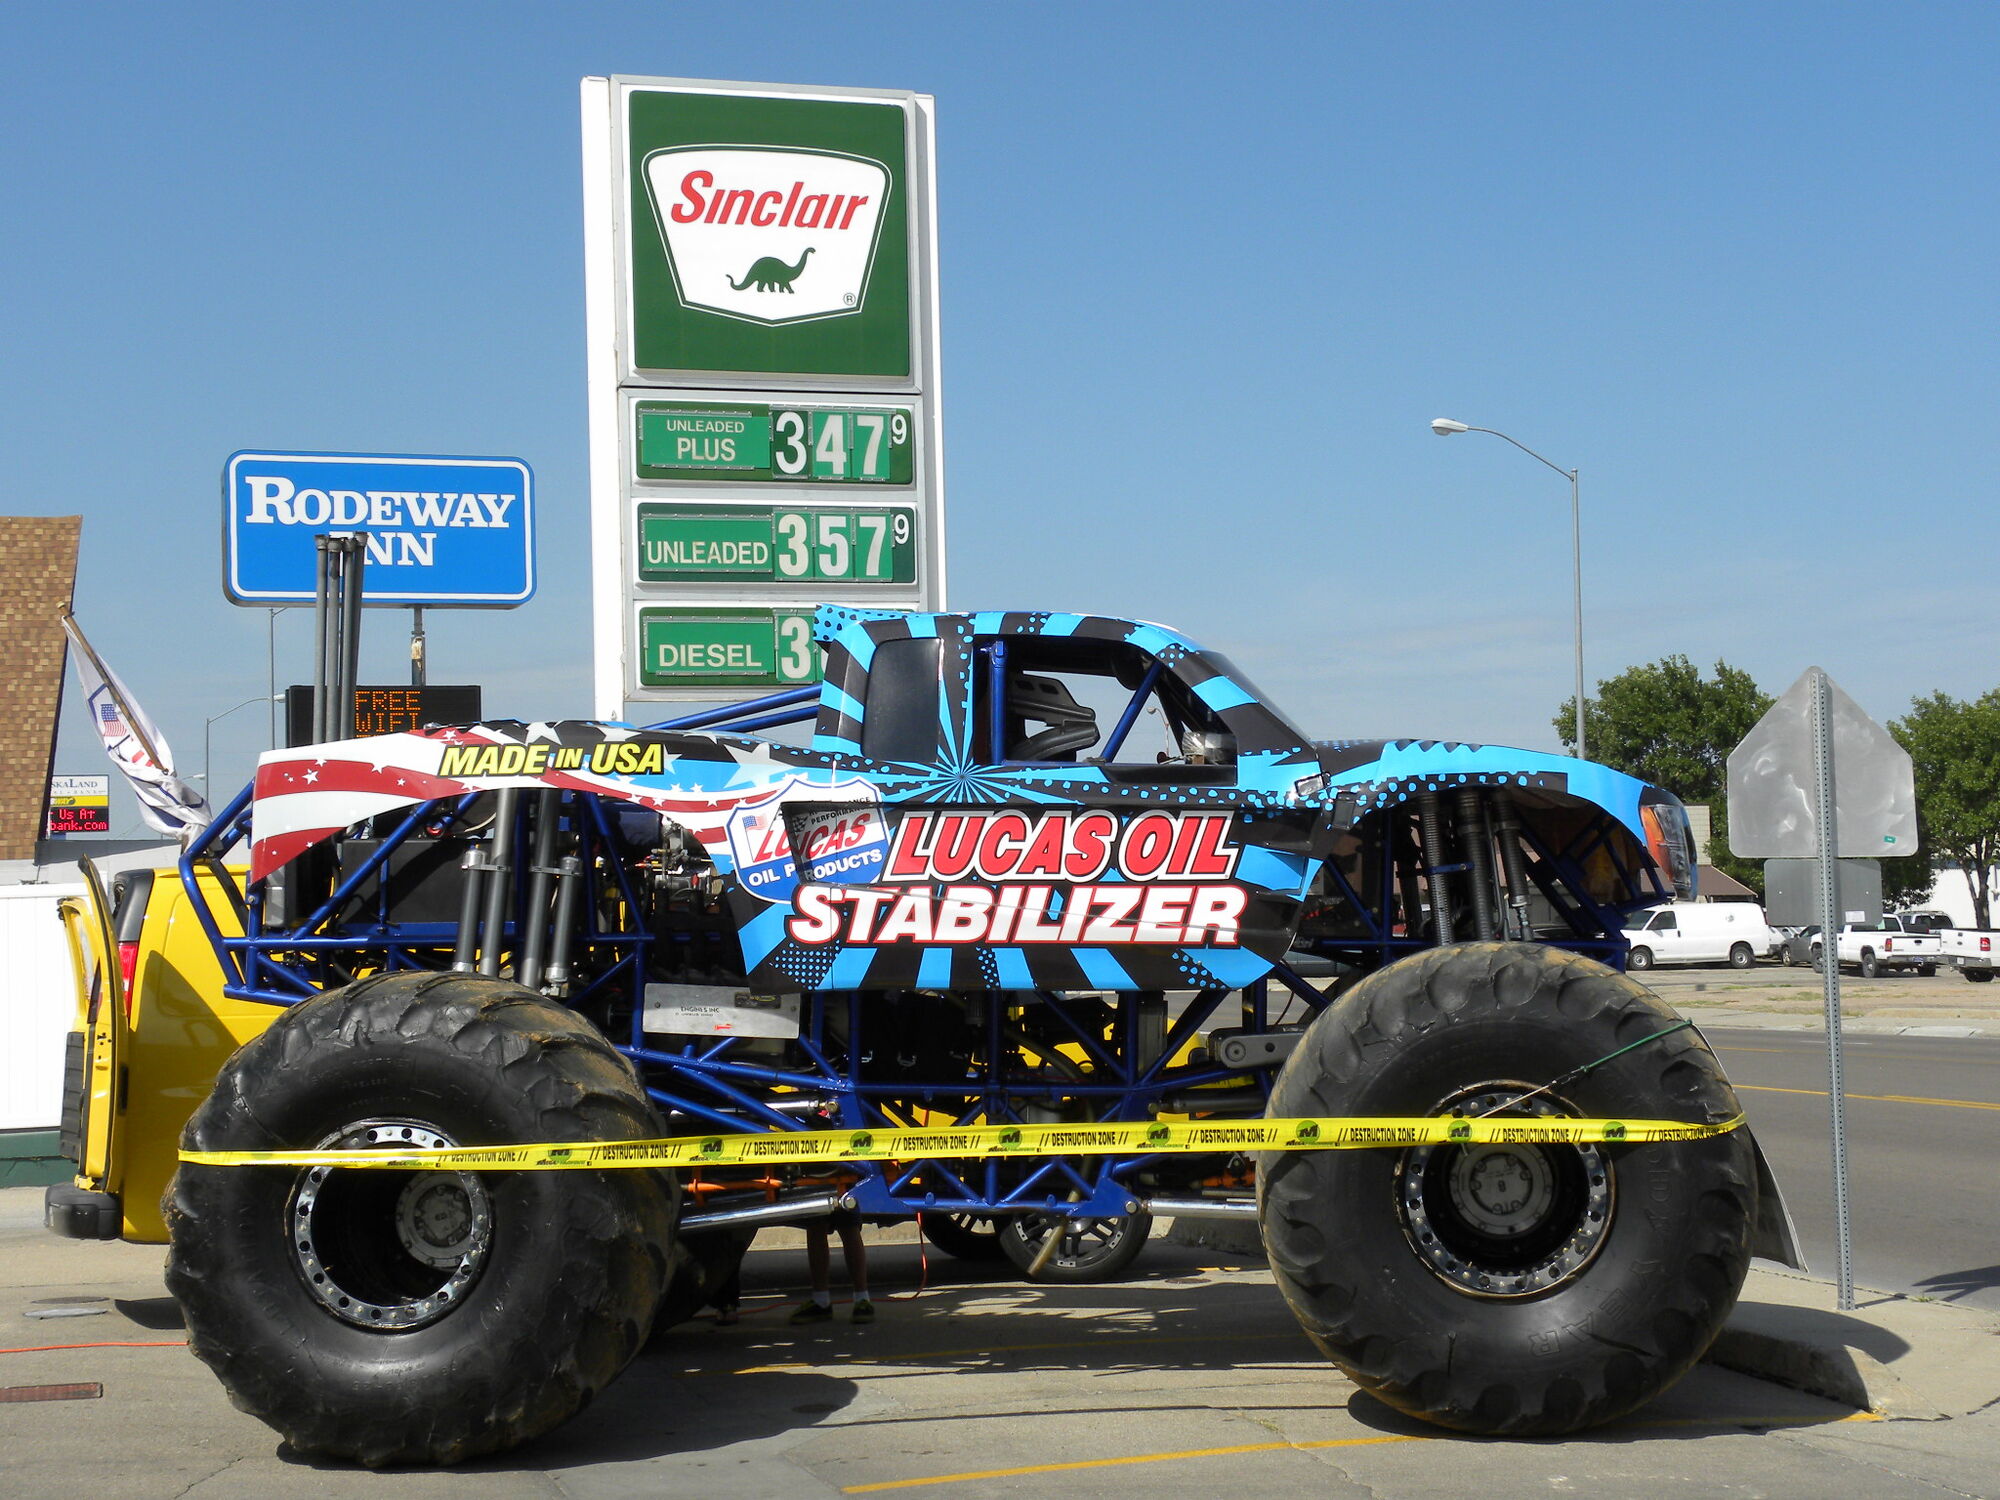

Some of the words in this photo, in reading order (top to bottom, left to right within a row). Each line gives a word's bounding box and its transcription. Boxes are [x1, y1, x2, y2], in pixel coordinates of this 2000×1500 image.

[671, 170, 869, 230] Sinclair
[666, 420, 745, 434] UNLEADED
[676, 437, 736, 462] PLUS
[774, 411, 885, 476] 347
[892, 414, 907, 445] 9
[245, 476, 516, 529] RODEWAY
[646, 540, 769, 565] UNLEADED
[778, 513, 888, 577] 357
[893, 513, 910, 545] 9
[658, 644, 762, 667] DIESEL
[355, 691, 421, 711] FREE
[355, 712, 419, 732] WIFI
[439, 744, 549, 776] MADE
[555, 748, 584, 769] IN
[590, 743, 663, 774] USA
[59, 809, 74, 820] Us
[753, 813, 871, 863] LUCAS
[885, 811, 1117, 881] LUCAS
[1118, 811, 1239, 881] OIL
[748, 868, 780, 887] OIL
[783, 848, 883, 882] PRODUCTS
[790, 885, 1247, 946] STABILIZER
[903, 1136, 949, 1151] DESTRUCTION
[950, 1135, 968, 1150] ZONE
[1052, 1132, 1098, 1146] DESTRUCTION
[1098, 1131, 1116, 1146] ZONE
[1200, 1129, 1246, 1143] DESTRUCTION
[1247, 1128, 1265, 1143] ZONE
[1350, 1127, 1396, 1142] DESTRUCTION
[1397, 1127, 1416, 1142] ZONE
[1503, 1128, 1549, 1143] DESTRUCTION
[1551, 1128, 1570, 1143] ZONE
[603, 1145, 649, 1160] DESTRUCTION
[650, 1144, 668, 1159] ZONE
[754, 1141, 800, 1156] DESTRUCTION
[801, 1139, 819, 1155] ZONE
